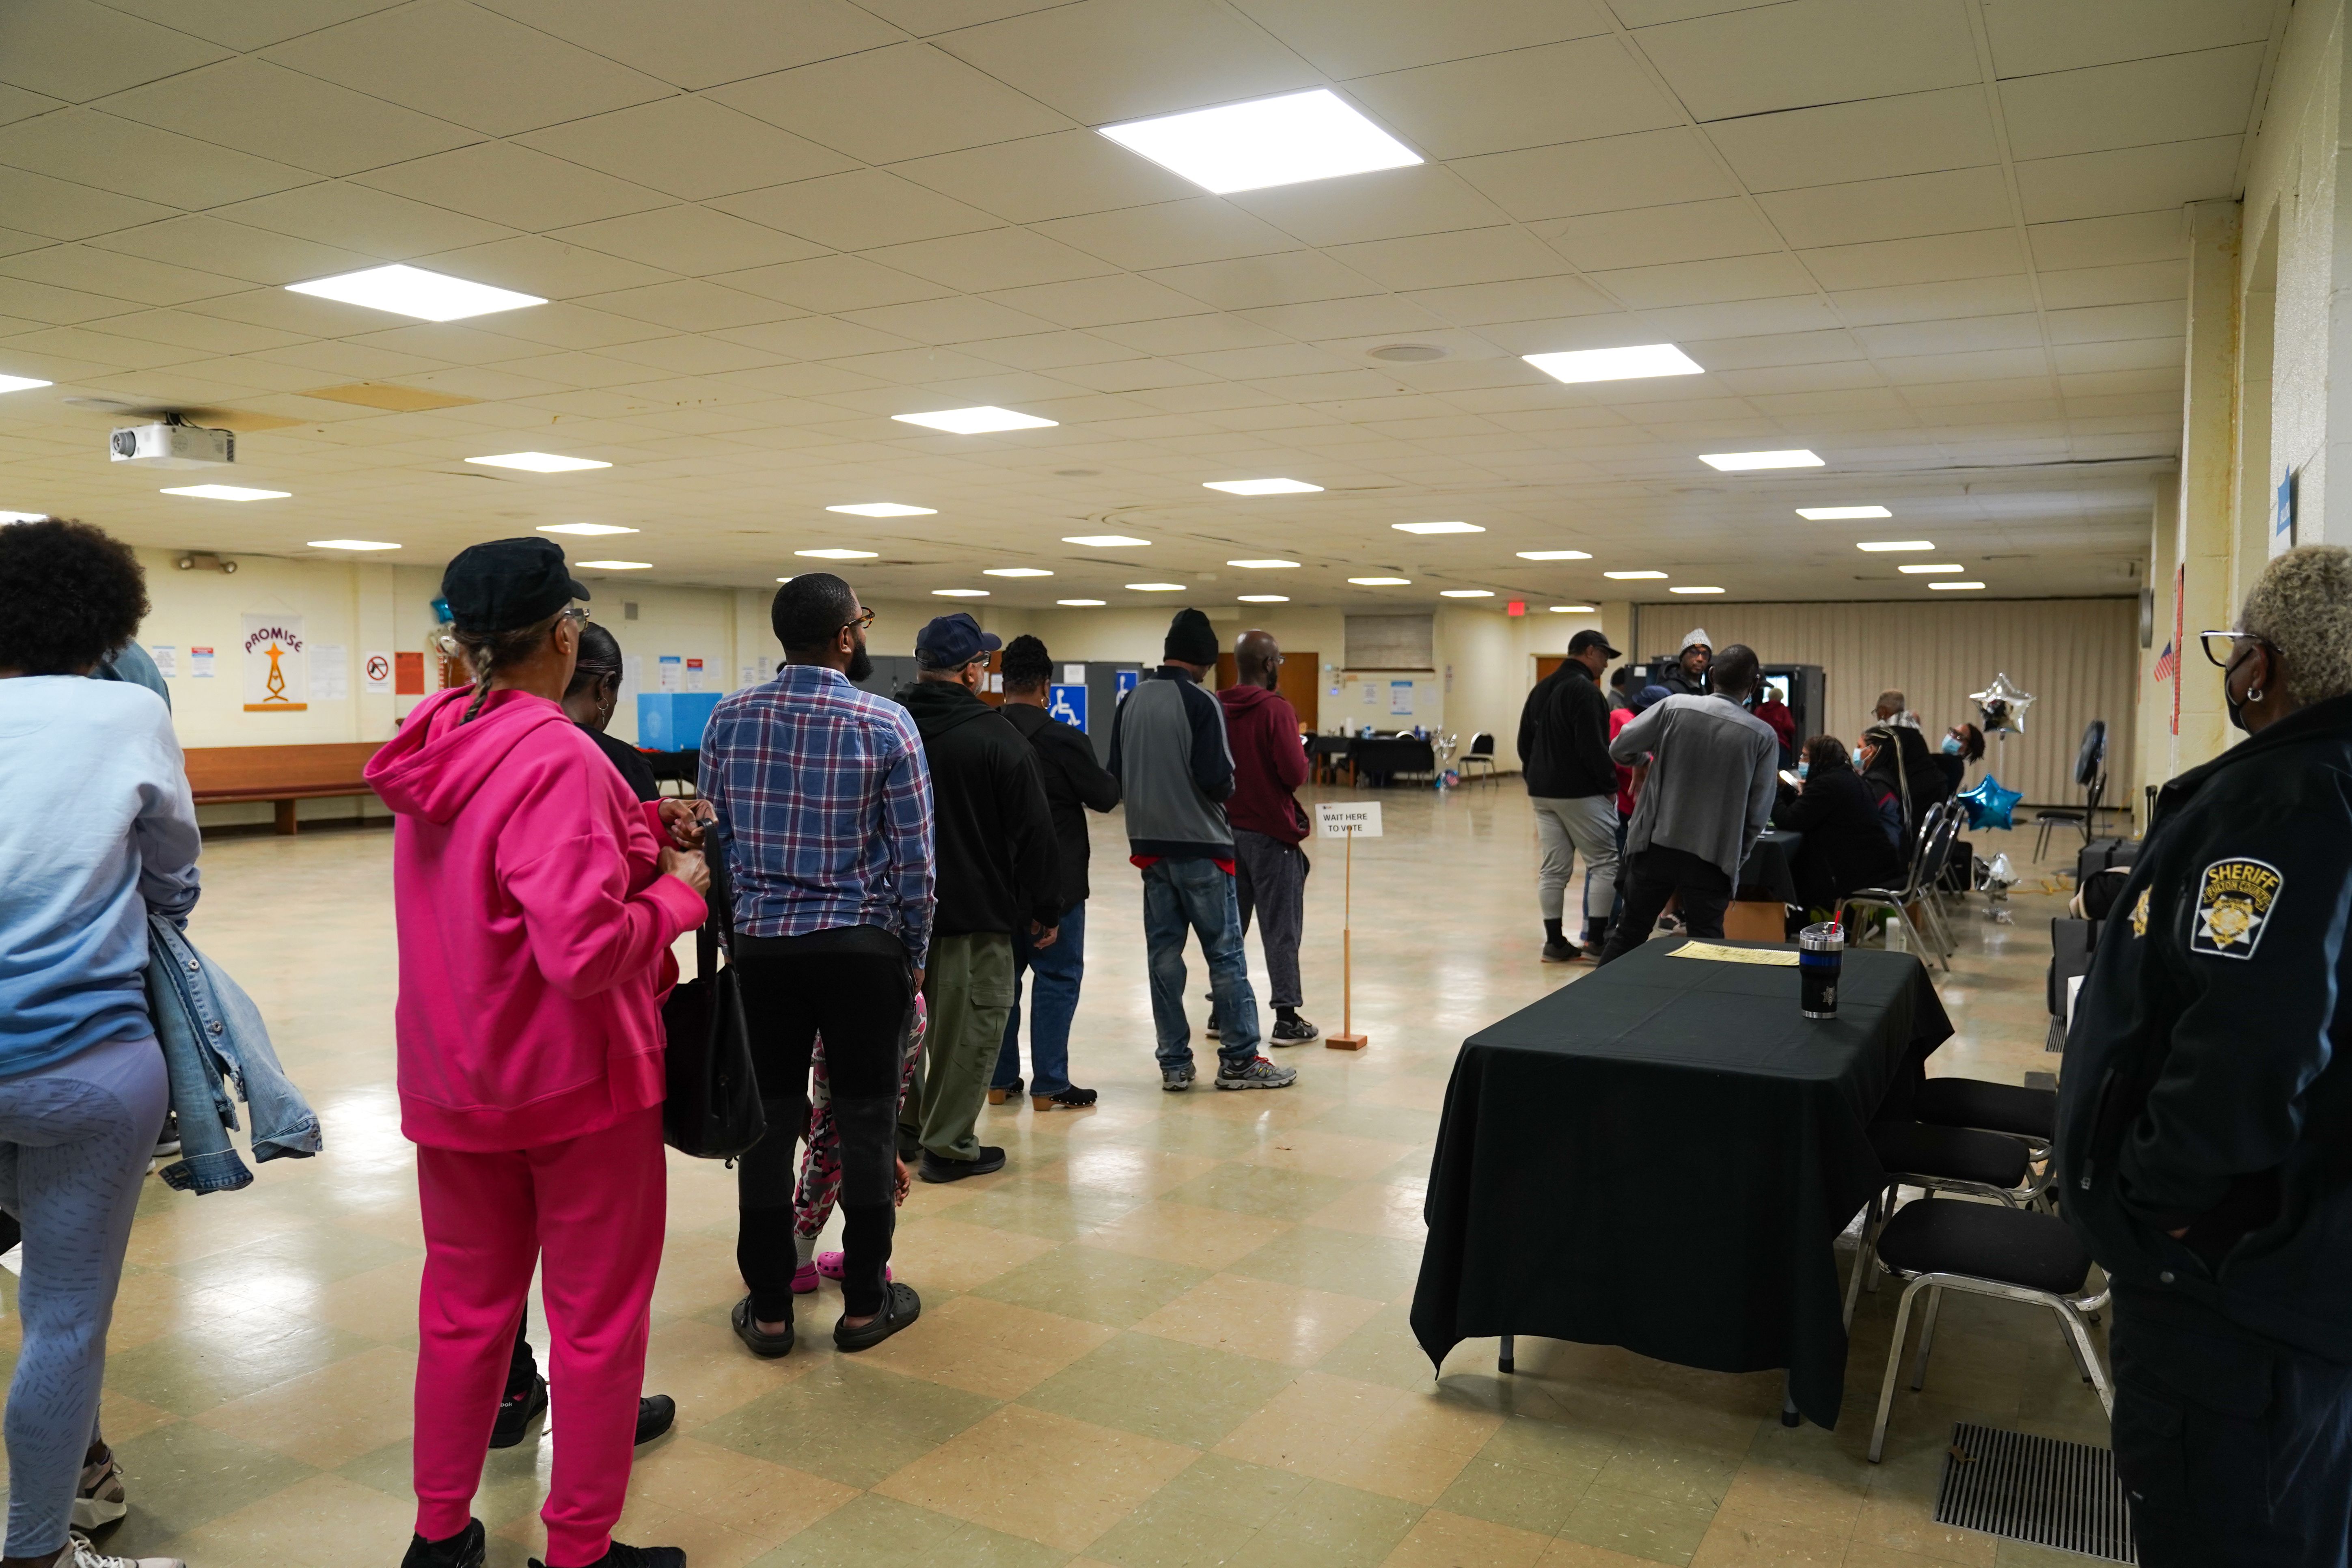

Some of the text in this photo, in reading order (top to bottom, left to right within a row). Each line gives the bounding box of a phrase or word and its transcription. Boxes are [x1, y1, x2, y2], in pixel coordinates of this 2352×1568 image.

[245, 627, 302, 654] PROMISE
[2206, 881, 2238, 896] FULTON
[2208, 863, 2279, 889] SHERIFF
